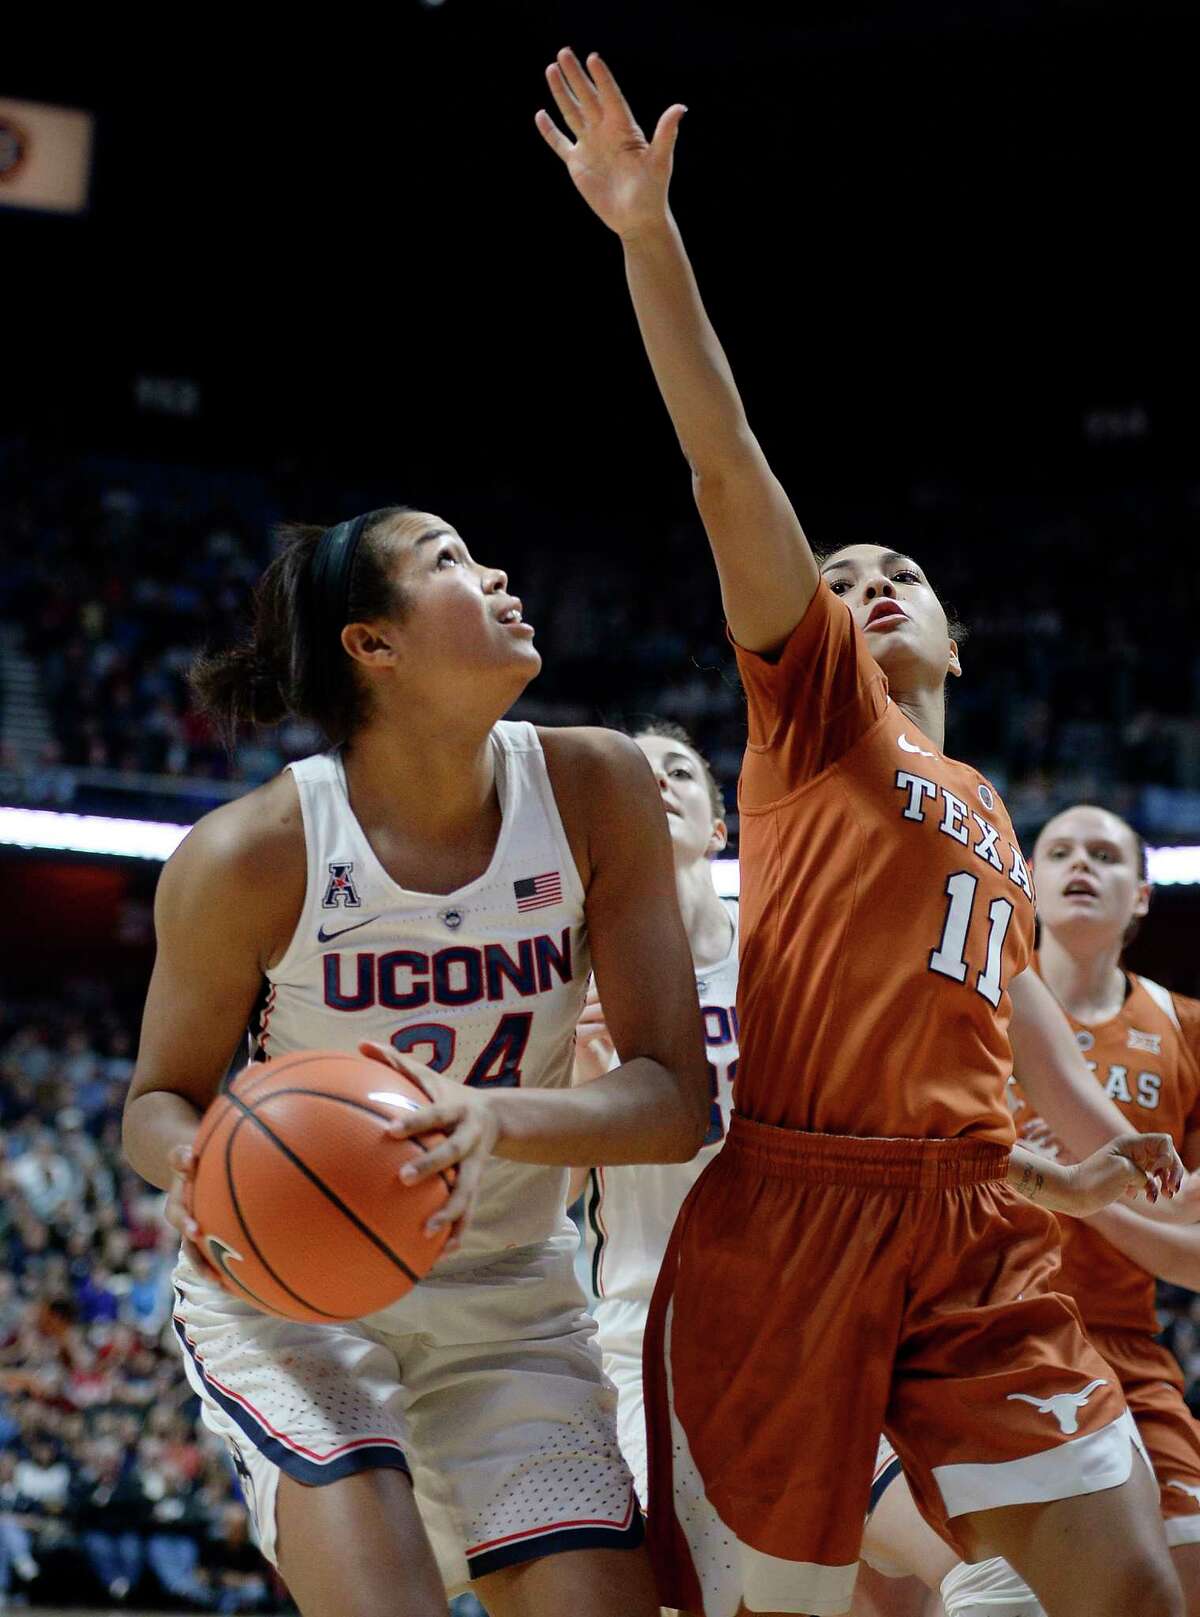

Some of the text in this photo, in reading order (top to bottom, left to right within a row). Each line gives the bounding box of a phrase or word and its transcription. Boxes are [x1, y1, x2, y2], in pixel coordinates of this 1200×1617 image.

[895, 769, 1036, 904] TEXA
[323, 926, 573, 1013] UCONN
[928, 870, 1015, 1010] 11
[1085, 1060, 1162, 1110] AS
